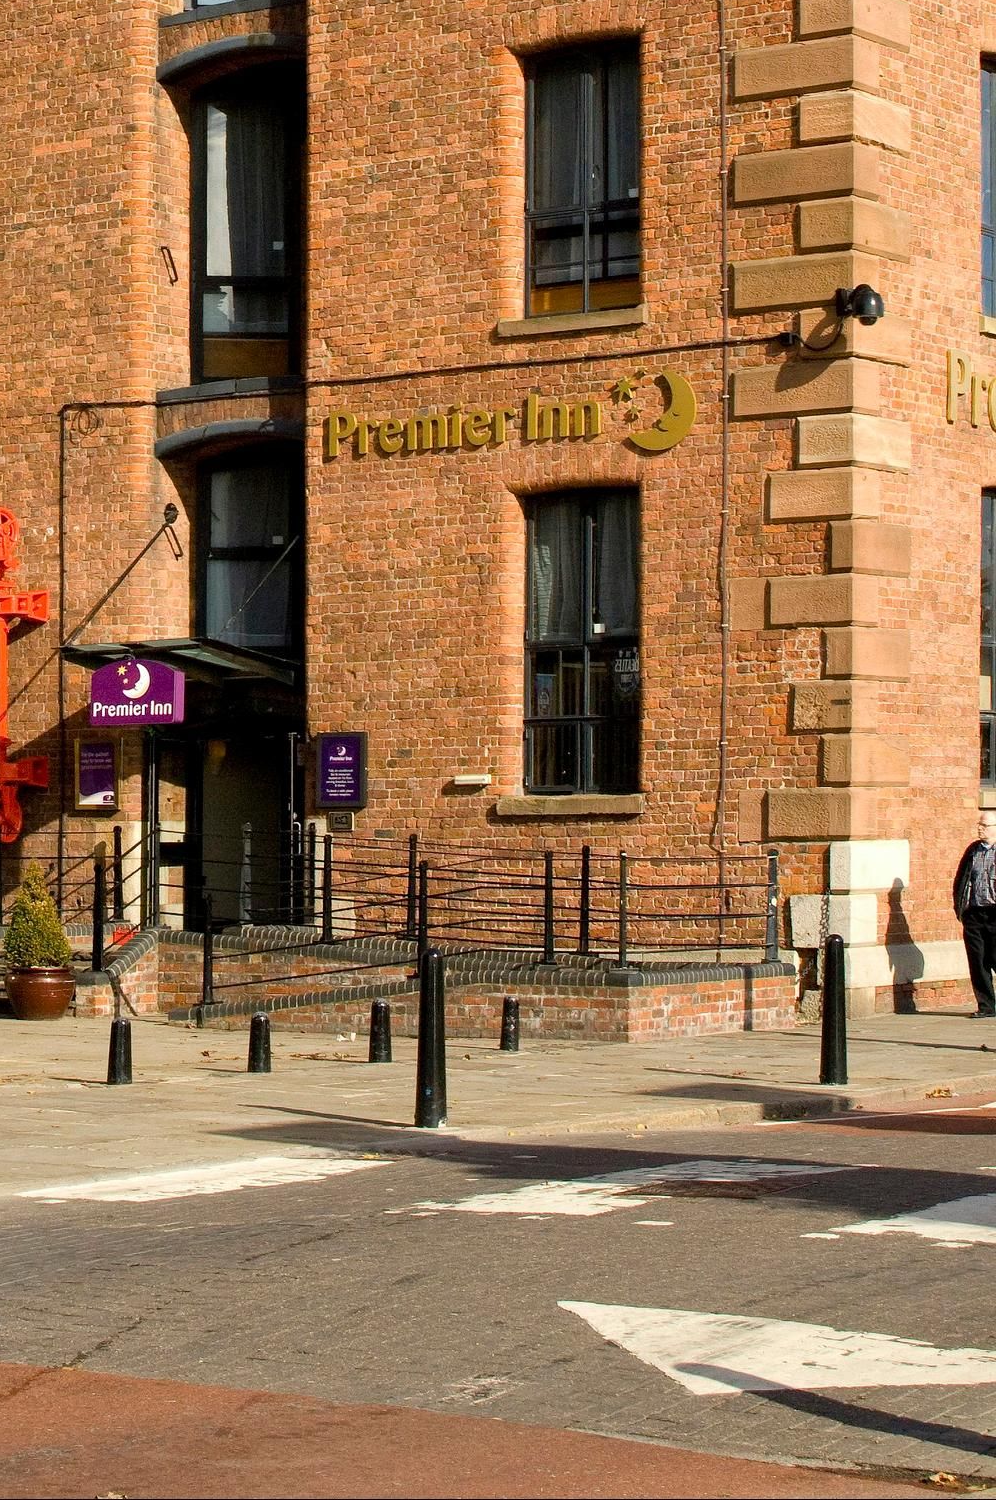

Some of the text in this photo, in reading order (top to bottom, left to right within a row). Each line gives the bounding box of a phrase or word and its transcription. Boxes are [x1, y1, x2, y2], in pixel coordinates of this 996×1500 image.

[326, 393, 604, 457] Premier Inn
[92, 700, 173, 717] Premier Inn
